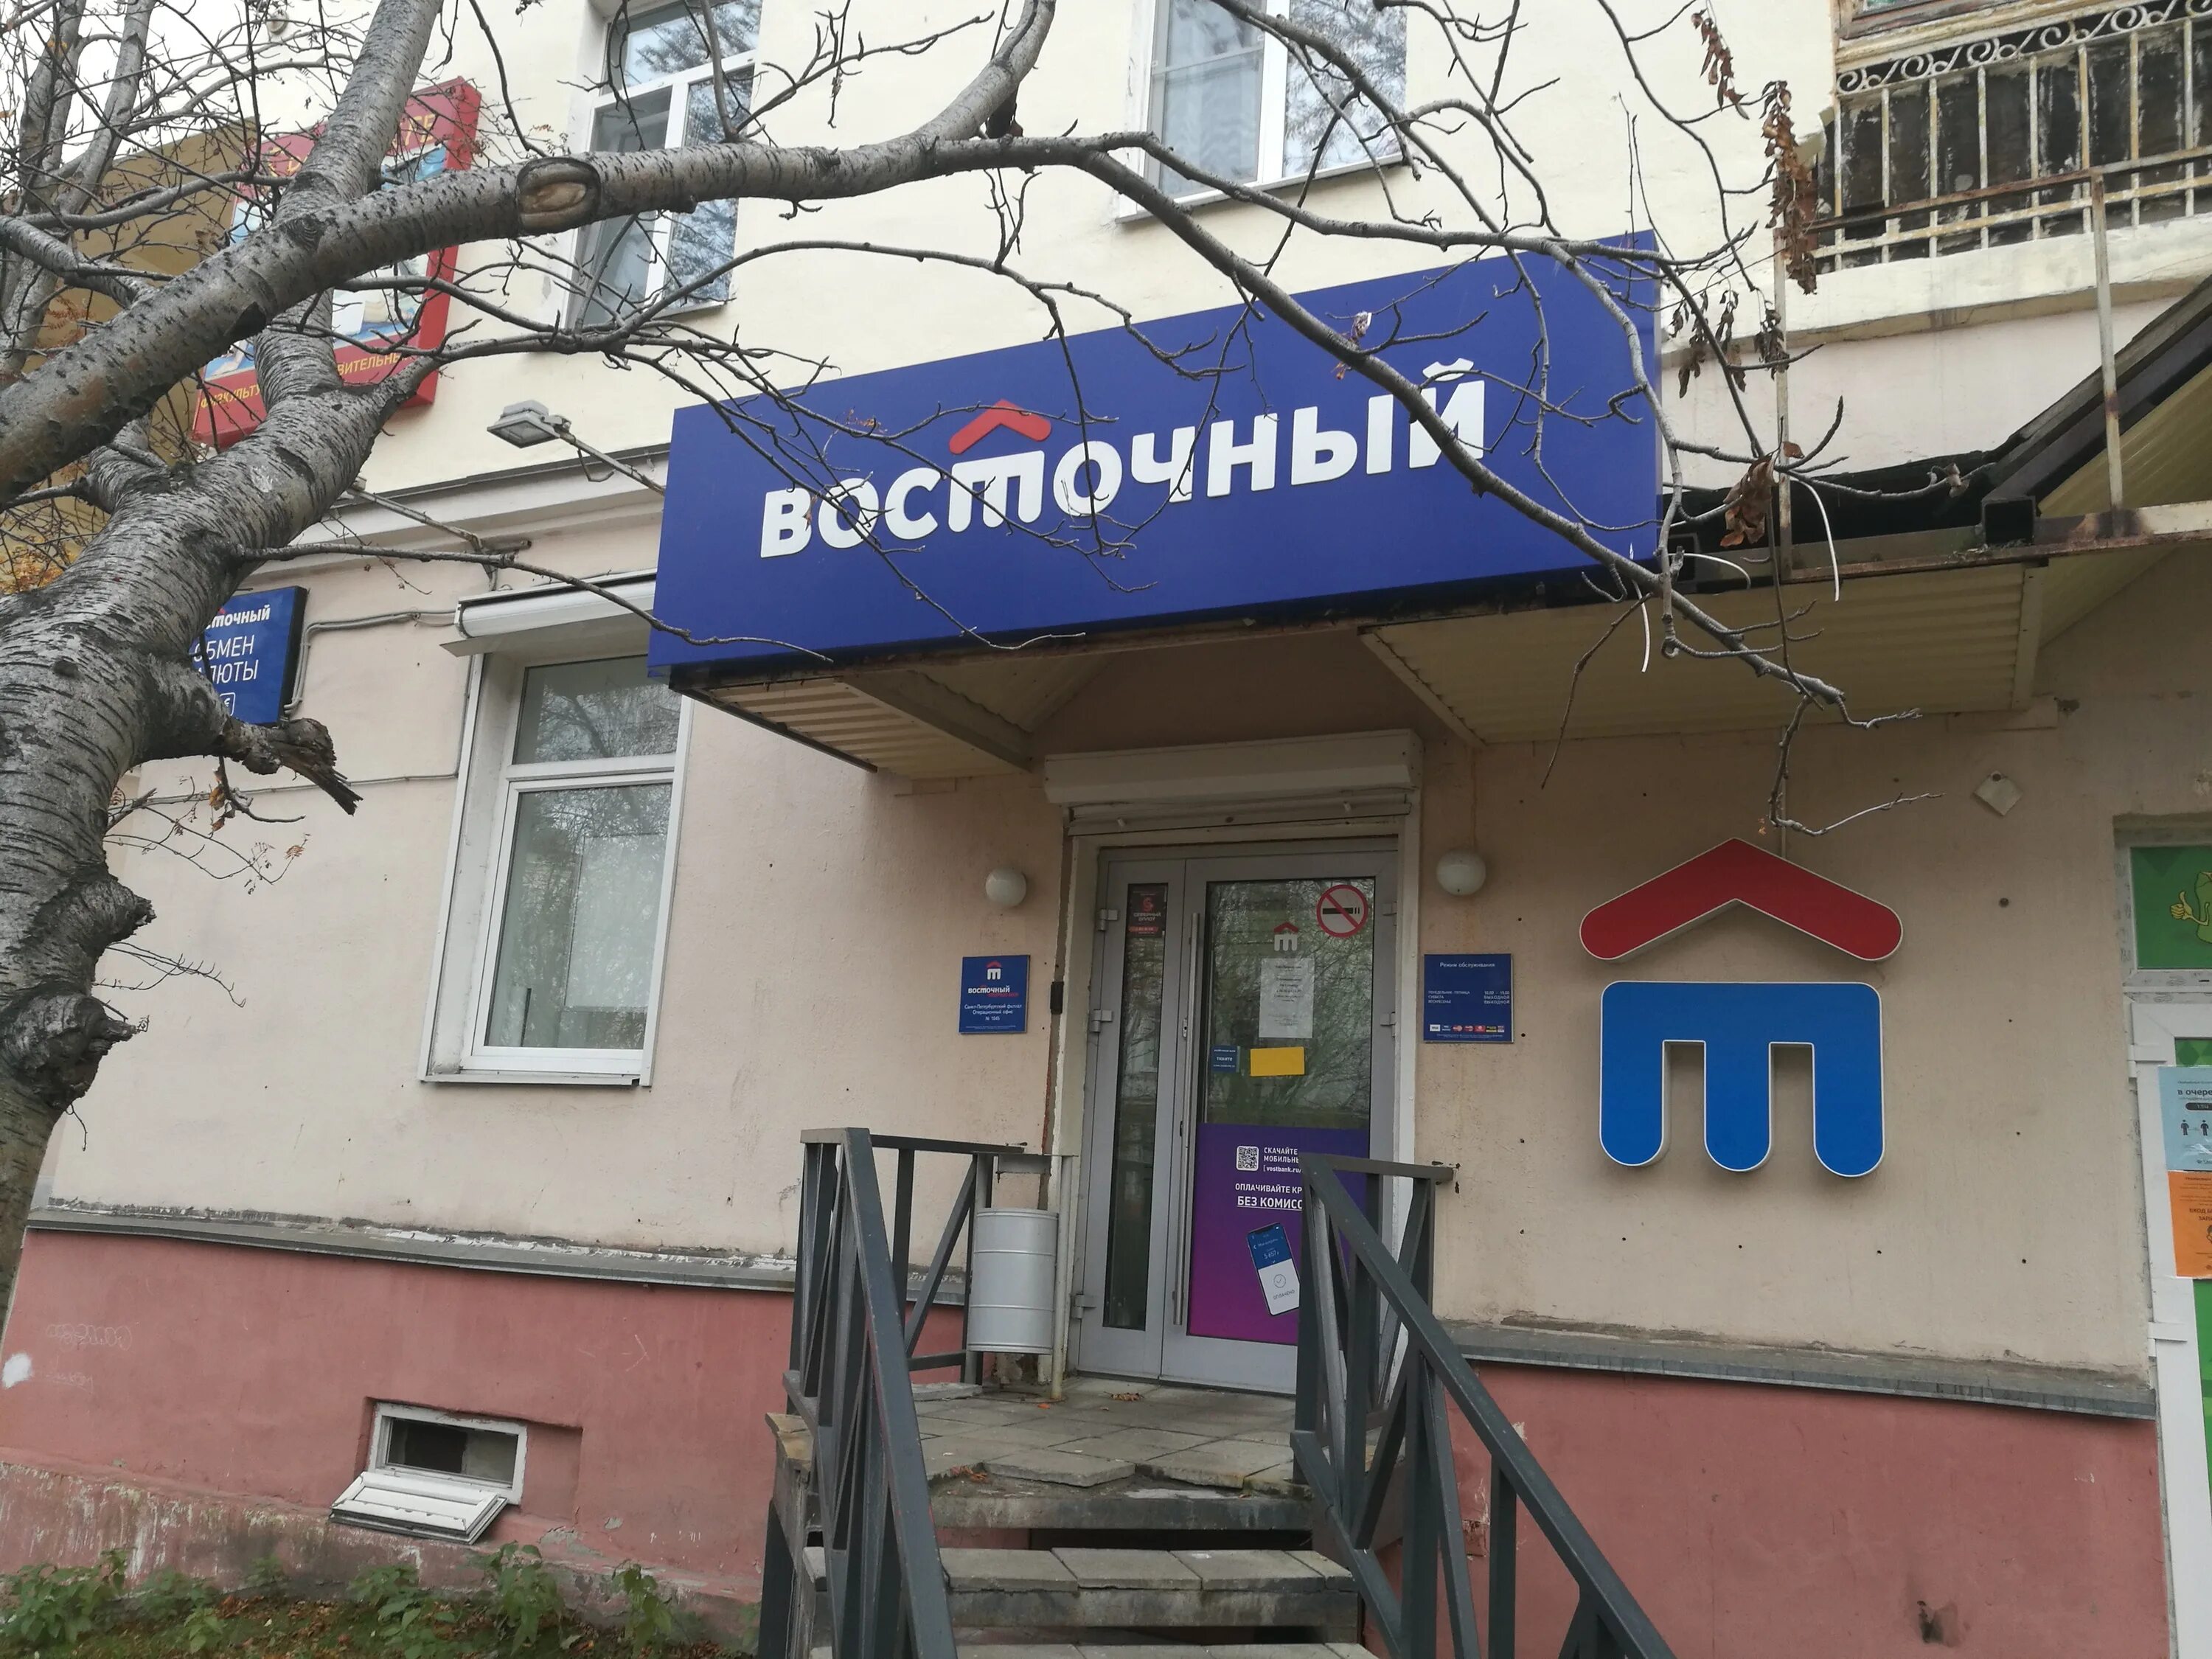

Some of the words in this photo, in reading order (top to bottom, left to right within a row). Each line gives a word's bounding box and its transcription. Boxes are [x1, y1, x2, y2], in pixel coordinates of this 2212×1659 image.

[206, 605, 271, 629] точный
[1264, 1147, 1298, 1155] СКАЧАЙТЕ
[1235, 1183, 1290, 1194] ОПЛАЧИВАЙТЕ
[1237, 1196, 1257, 1206] БЕЗ
[1260, 1197, 1303, 1209] КОМИСС
